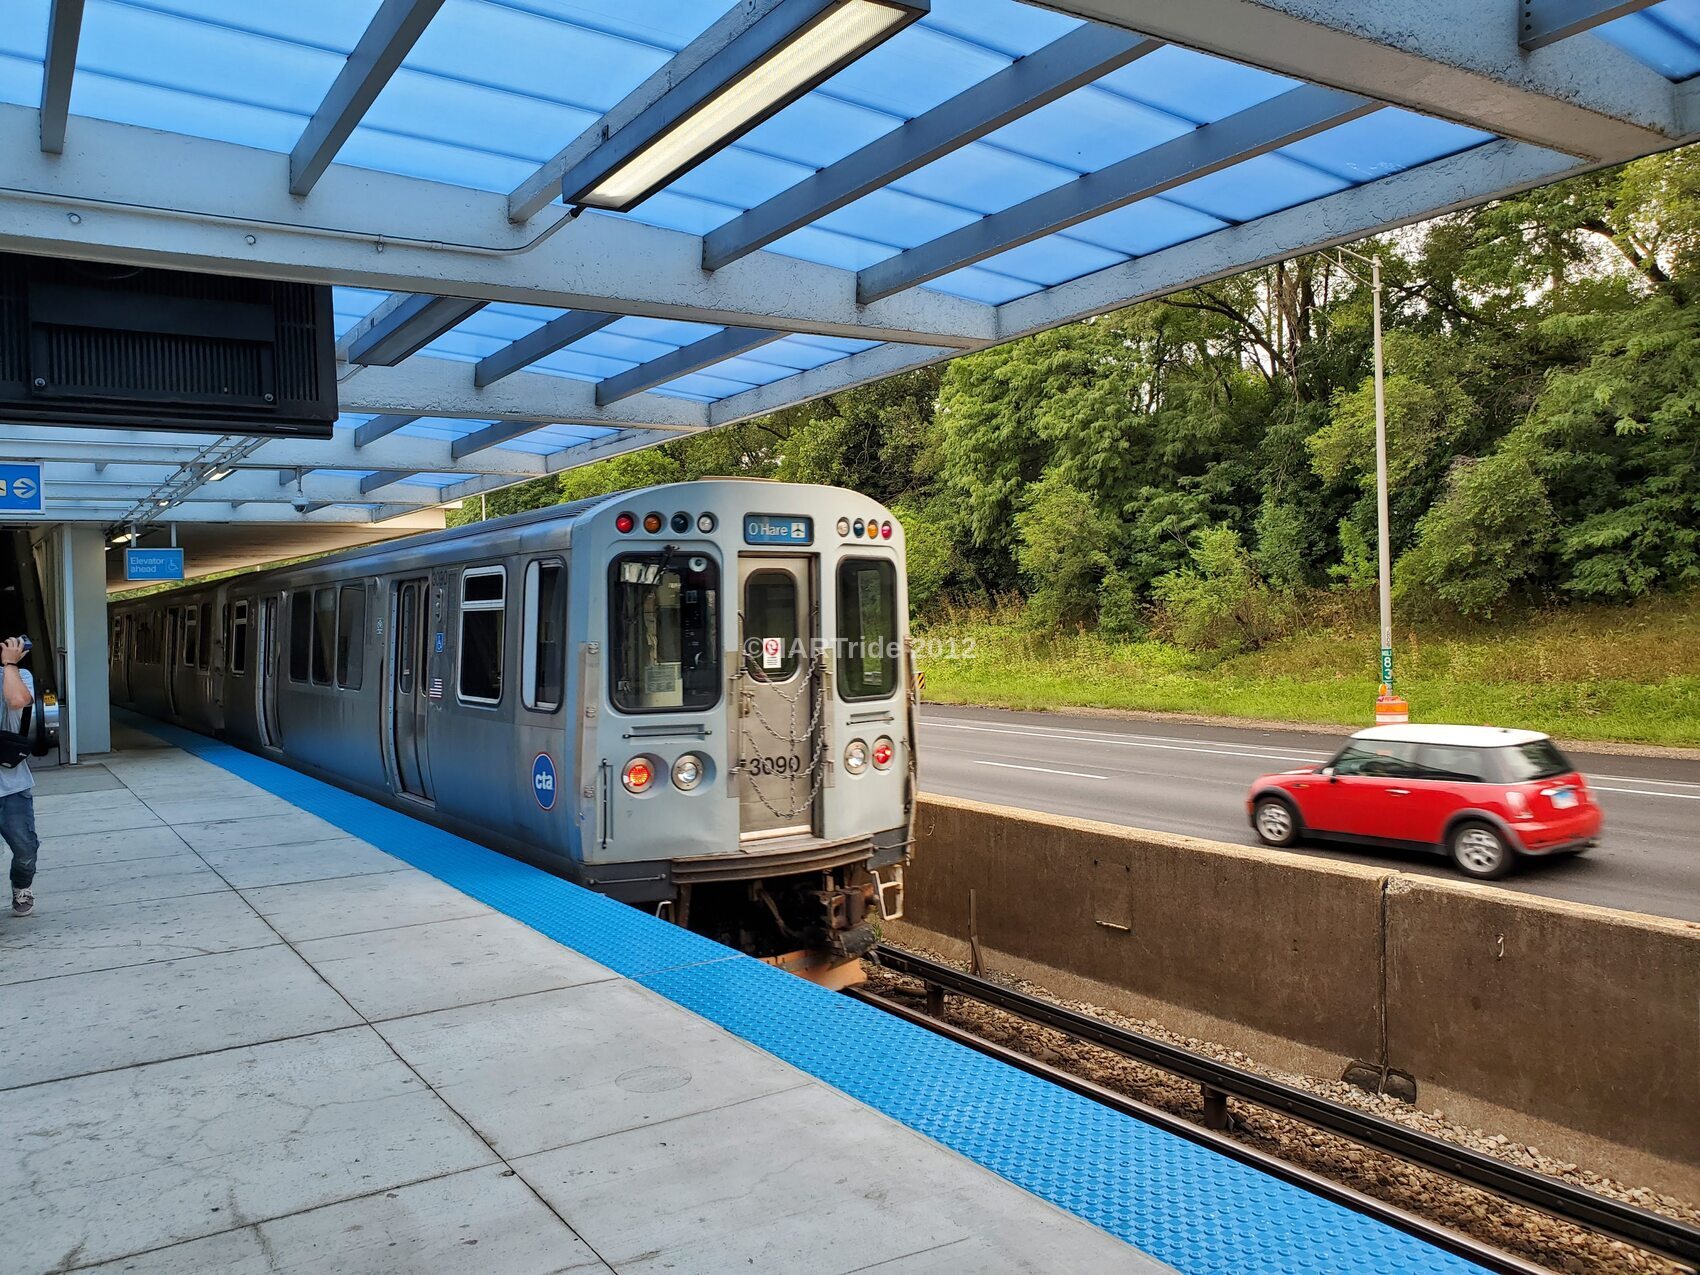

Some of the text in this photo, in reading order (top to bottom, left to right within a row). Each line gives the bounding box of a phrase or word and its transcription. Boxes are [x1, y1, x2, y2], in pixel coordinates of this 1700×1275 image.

[130, 557, 164, 565] Elevator
[131, 565, 157, 573] ahead
[750, 755, 800, 776] 3090
[535, 771, 553, 790] cta
